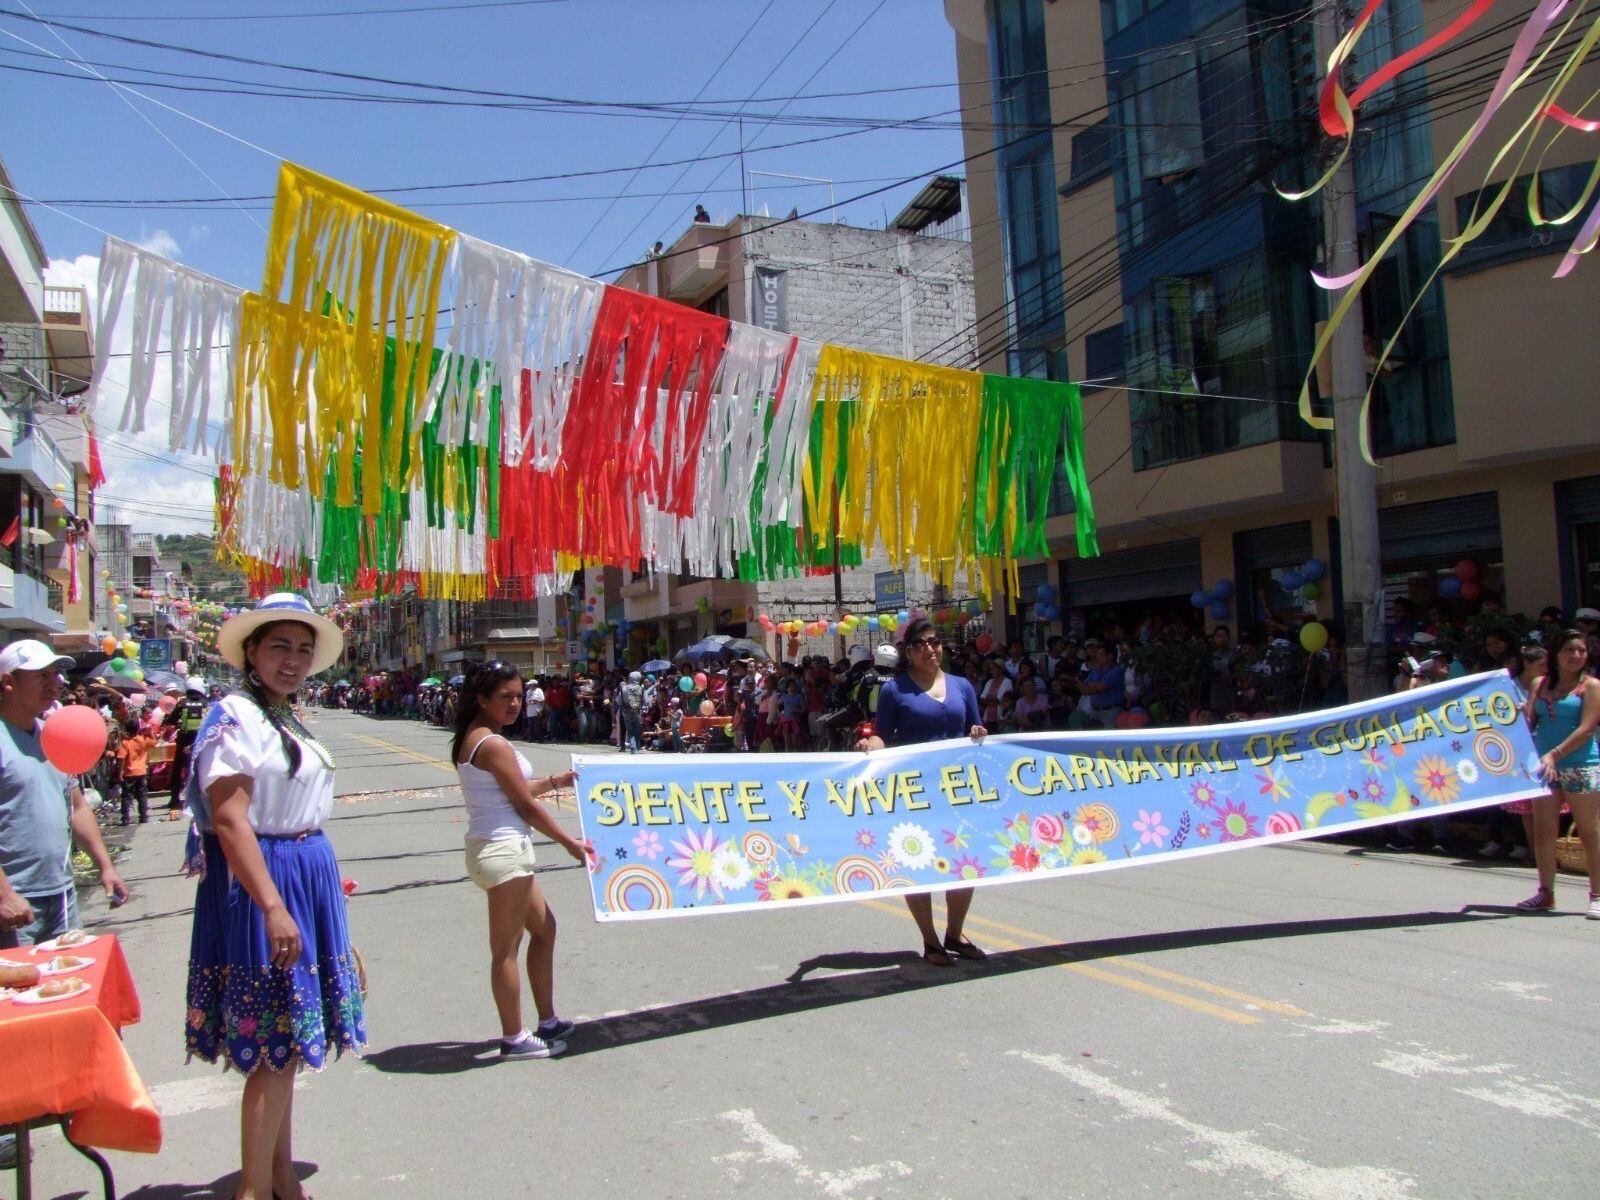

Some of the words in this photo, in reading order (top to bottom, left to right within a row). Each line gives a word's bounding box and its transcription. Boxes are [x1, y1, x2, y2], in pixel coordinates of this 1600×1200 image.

[589, 779, 771, 826] SIENTE
[777, 779, 810, 818] Y
[825, 771, 931, 816] VIVE
[939, 765, 999, 805] EL
[1008, 738, 1235, 795] CARNAVAL
[1244, 729, 1302, 766] DE
[1308, 690, 1518, 755] GUALACEO
